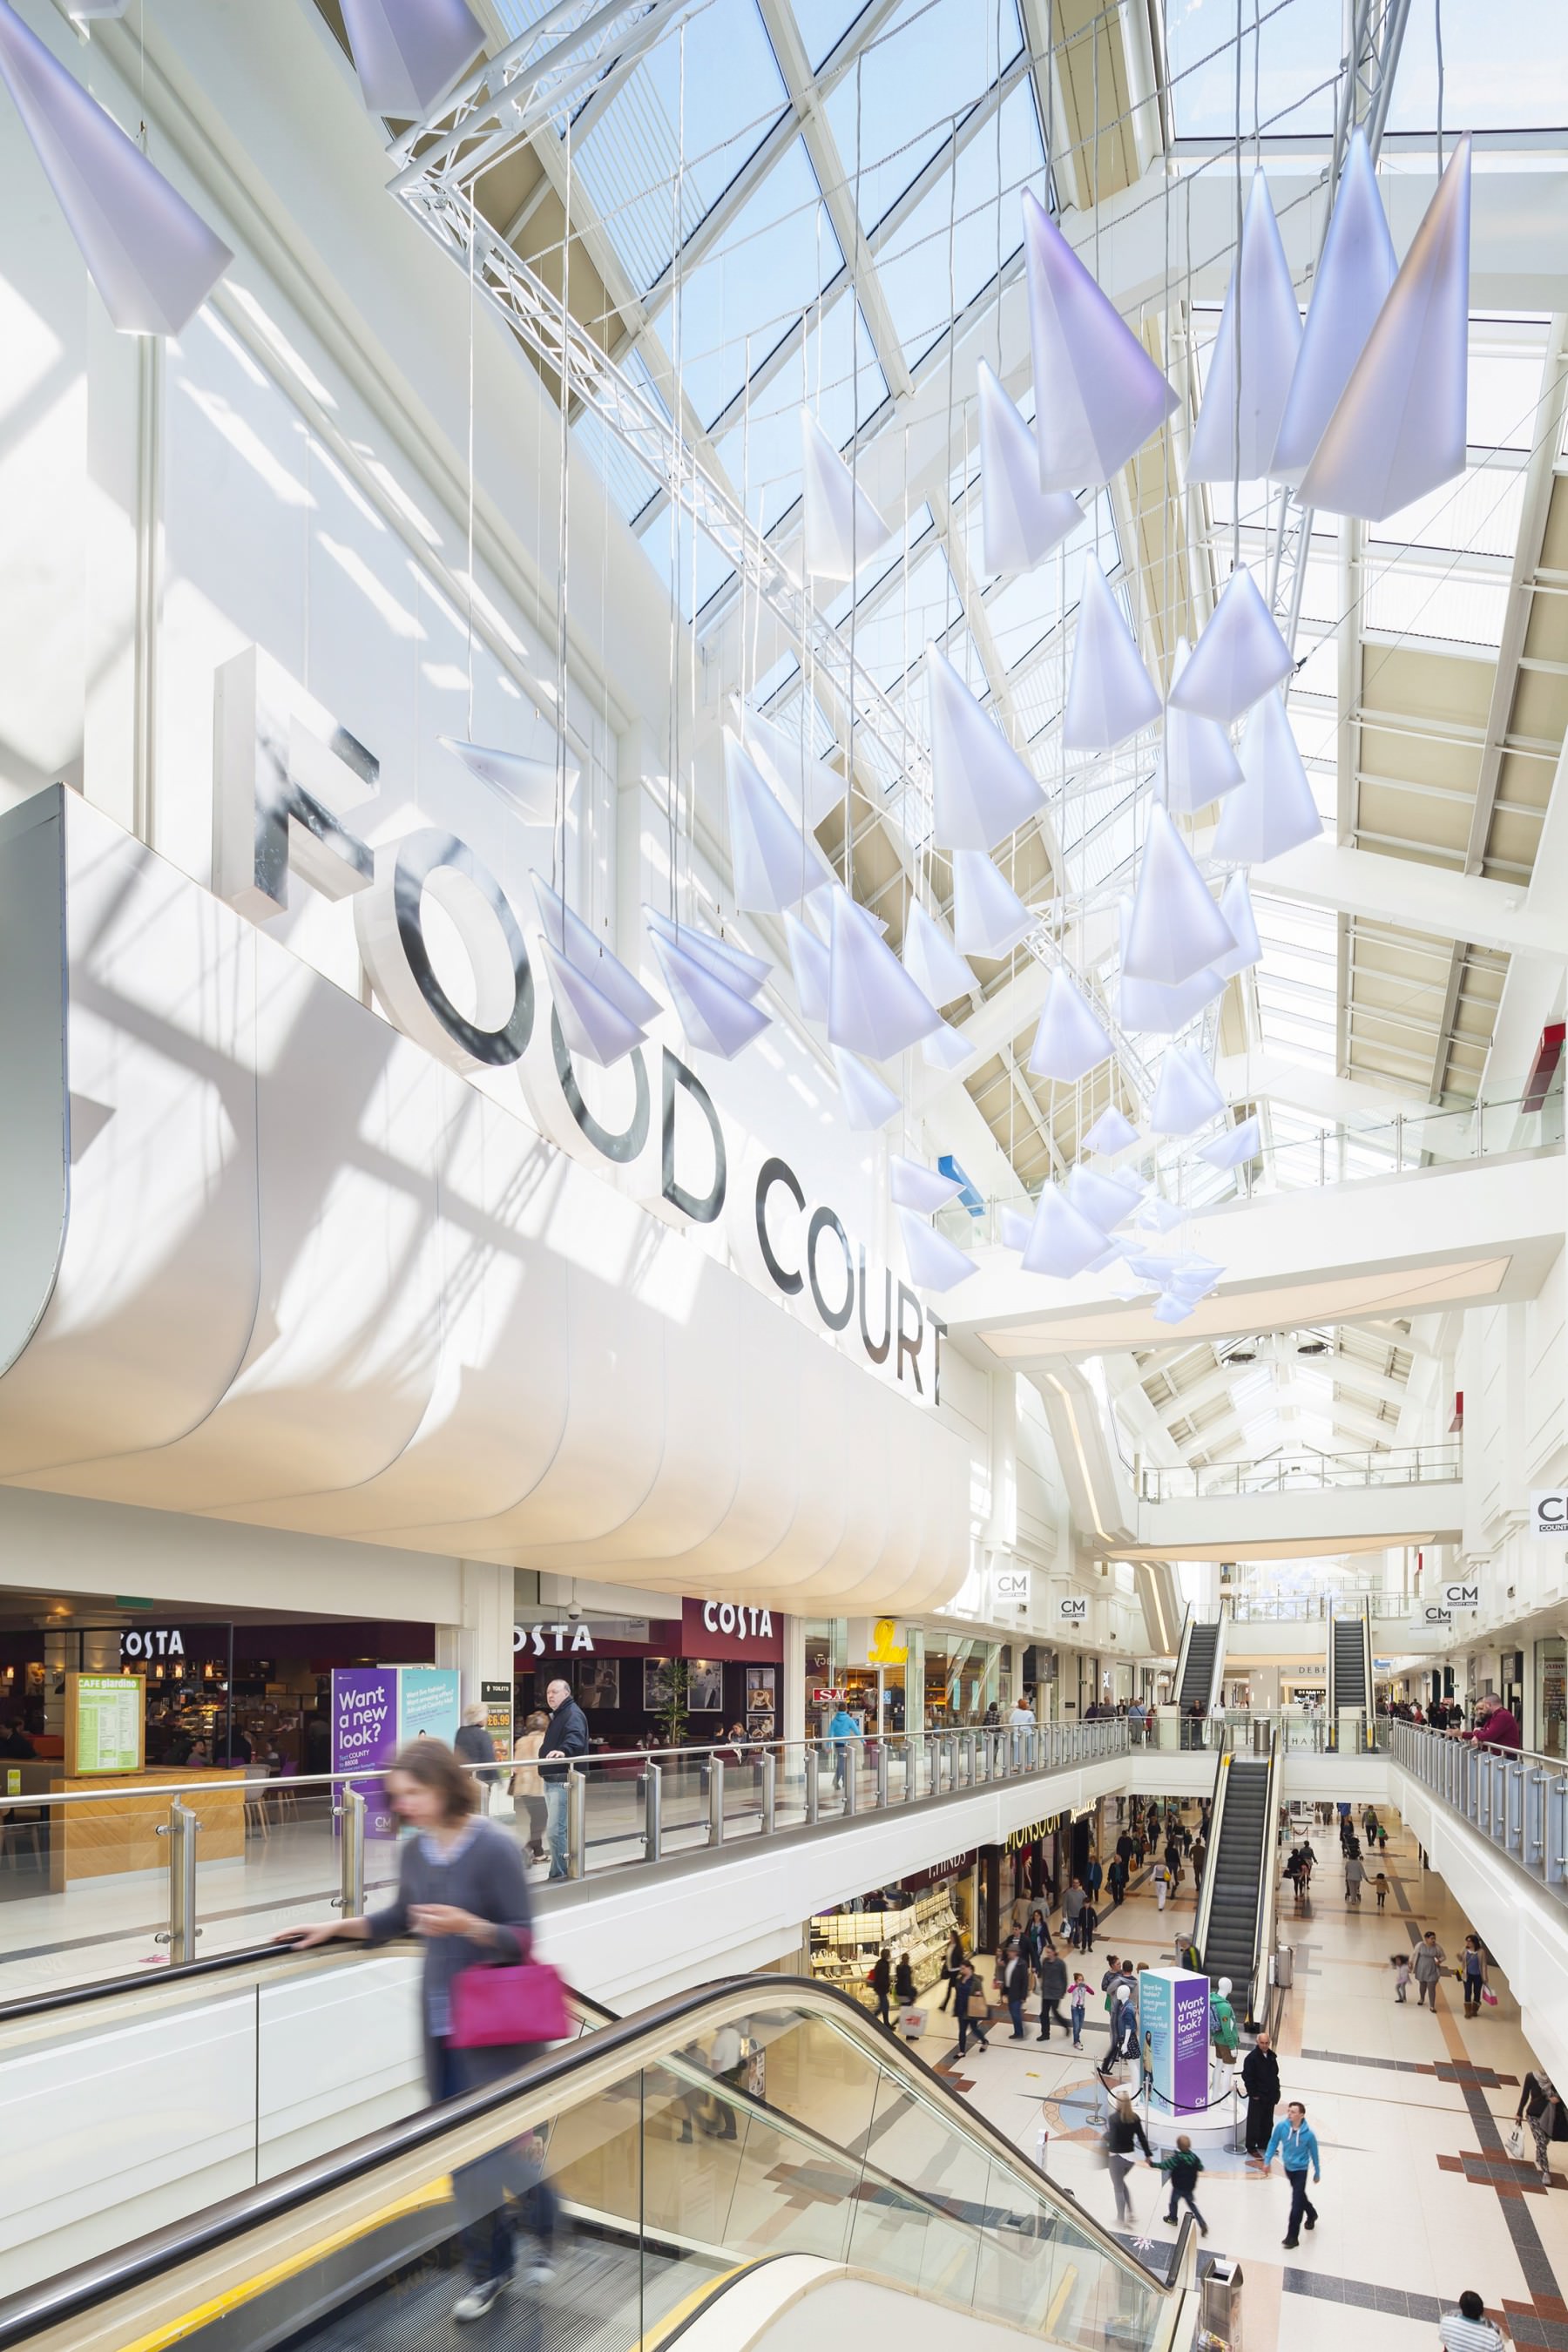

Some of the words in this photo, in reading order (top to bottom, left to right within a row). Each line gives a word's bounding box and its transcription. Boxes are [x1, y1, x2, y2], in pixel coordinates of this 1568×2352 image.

[213, 643, 727, 1226] FOOD
[754, 1156, 949, 1408] COURT
[1538, 1497, 1568, 1521] C
[997, 1576, 1027, 1592] CM
[1447, 1586, 1477, 1600] CM
[1061, 1600, 1085, 1612] CM
[1425, 1607, 1451, 1619] CM
[704, 1600, 774, 1640] COSTA
[120, 1631, 185, 1659] OSTA
[78, 1679, 100, 1687] CAFE
[339, 1686, 385, 1711] Want
[339, 1714, 348, 1728] a
[353, 1706, 388, 1727] new
[339, 1723, 382, 1749] look?
[348, 1749, 369, 1759] COUNTY
[1004, 1813, 1060, 1854] MONSOON
[1178, 1996, 1204, 2012] Want
[1186, 2006, 1206, 2020] new
[1178, 2016, 1202, 2034] look?
